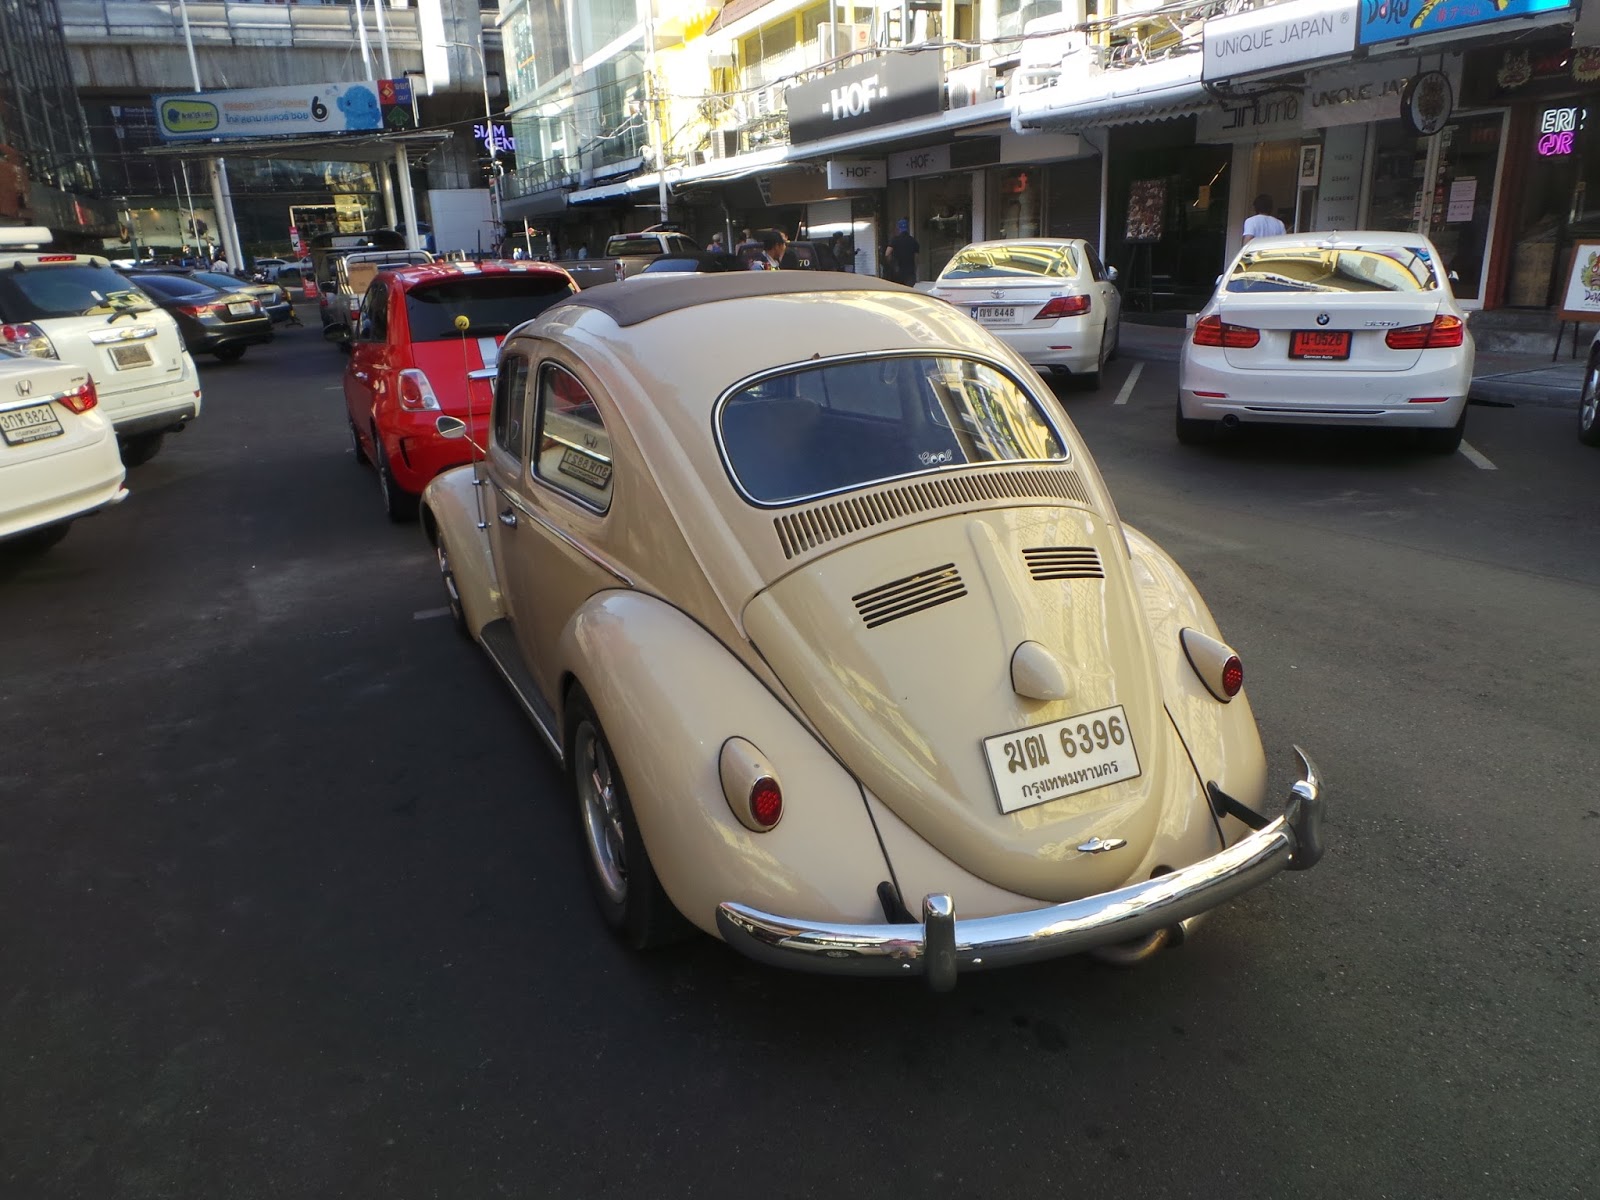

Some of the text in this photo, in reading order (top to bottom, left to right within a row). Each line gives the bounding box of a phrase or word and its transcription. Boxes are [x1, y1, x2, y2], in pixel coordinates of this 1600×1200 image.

[1280, 15, 1334, 44] JAPAN
[311, 95, 329, 122] 6
[994, 308, 1015, 317] 6448
[25, 408, 53, 424] 8821
[1059, 715, 1125, 758] 6396
[1021, 760, 1119, 799] กรุงเทพมหานคร
